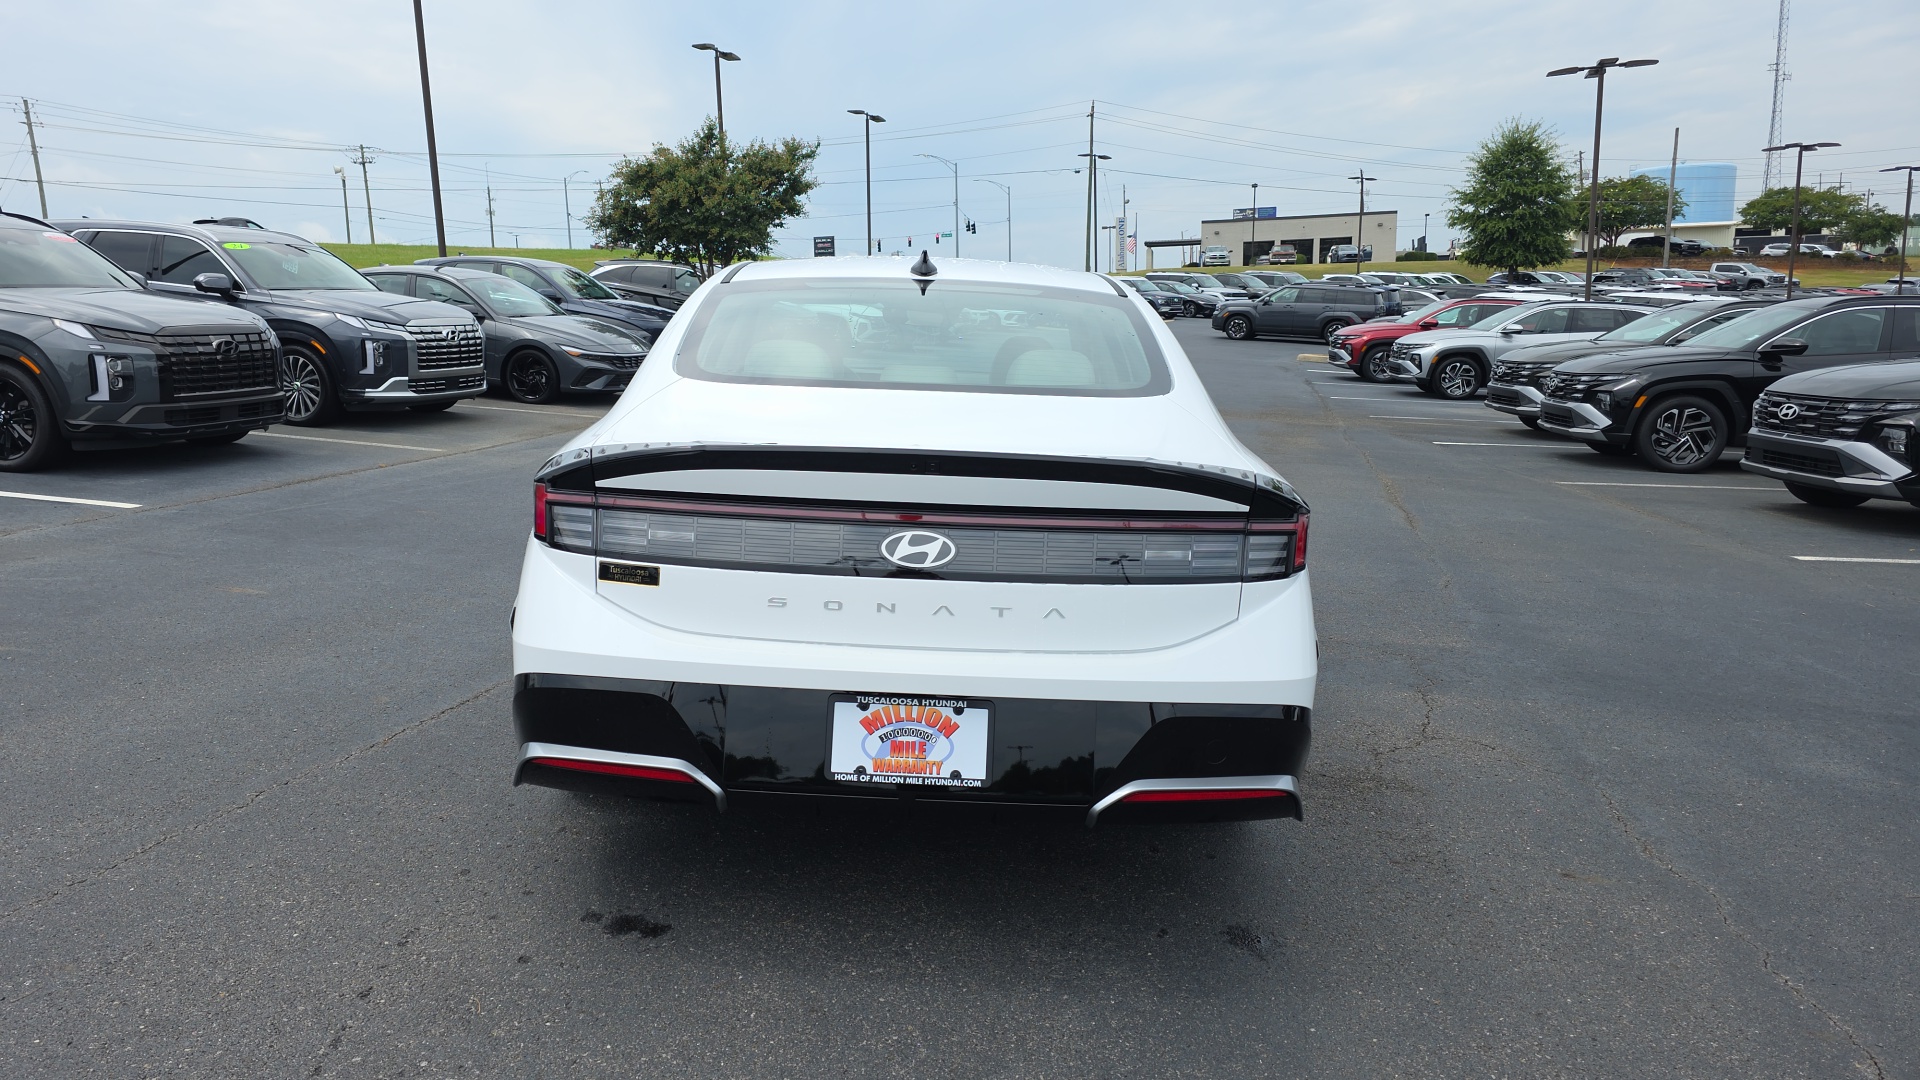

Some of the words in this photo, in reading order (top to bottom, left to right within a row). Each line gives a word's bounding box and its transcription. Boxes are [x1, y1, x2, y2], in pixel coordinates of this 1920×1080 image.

[610, 565, 649, 576] Tuscaloosa
[767, 596, 1066, 619] SONATA
[856, 696, 919, 706] TUSCALOOSA
[921, 699, 967, 708] HYUNDAI
[859, 704, 961, 739] MILLION
[889, 740, 927, 759] MILE
[871, 757, 944, 775] WARRANTY
[834, 773, 858, 782] HOME
[859, 775, 871, 783] OF
[872, 776, 904, 784] MILLION
[905, 777, 923, 785] MILE
[924, 778, 982, 788] HYUNDAI.COM
